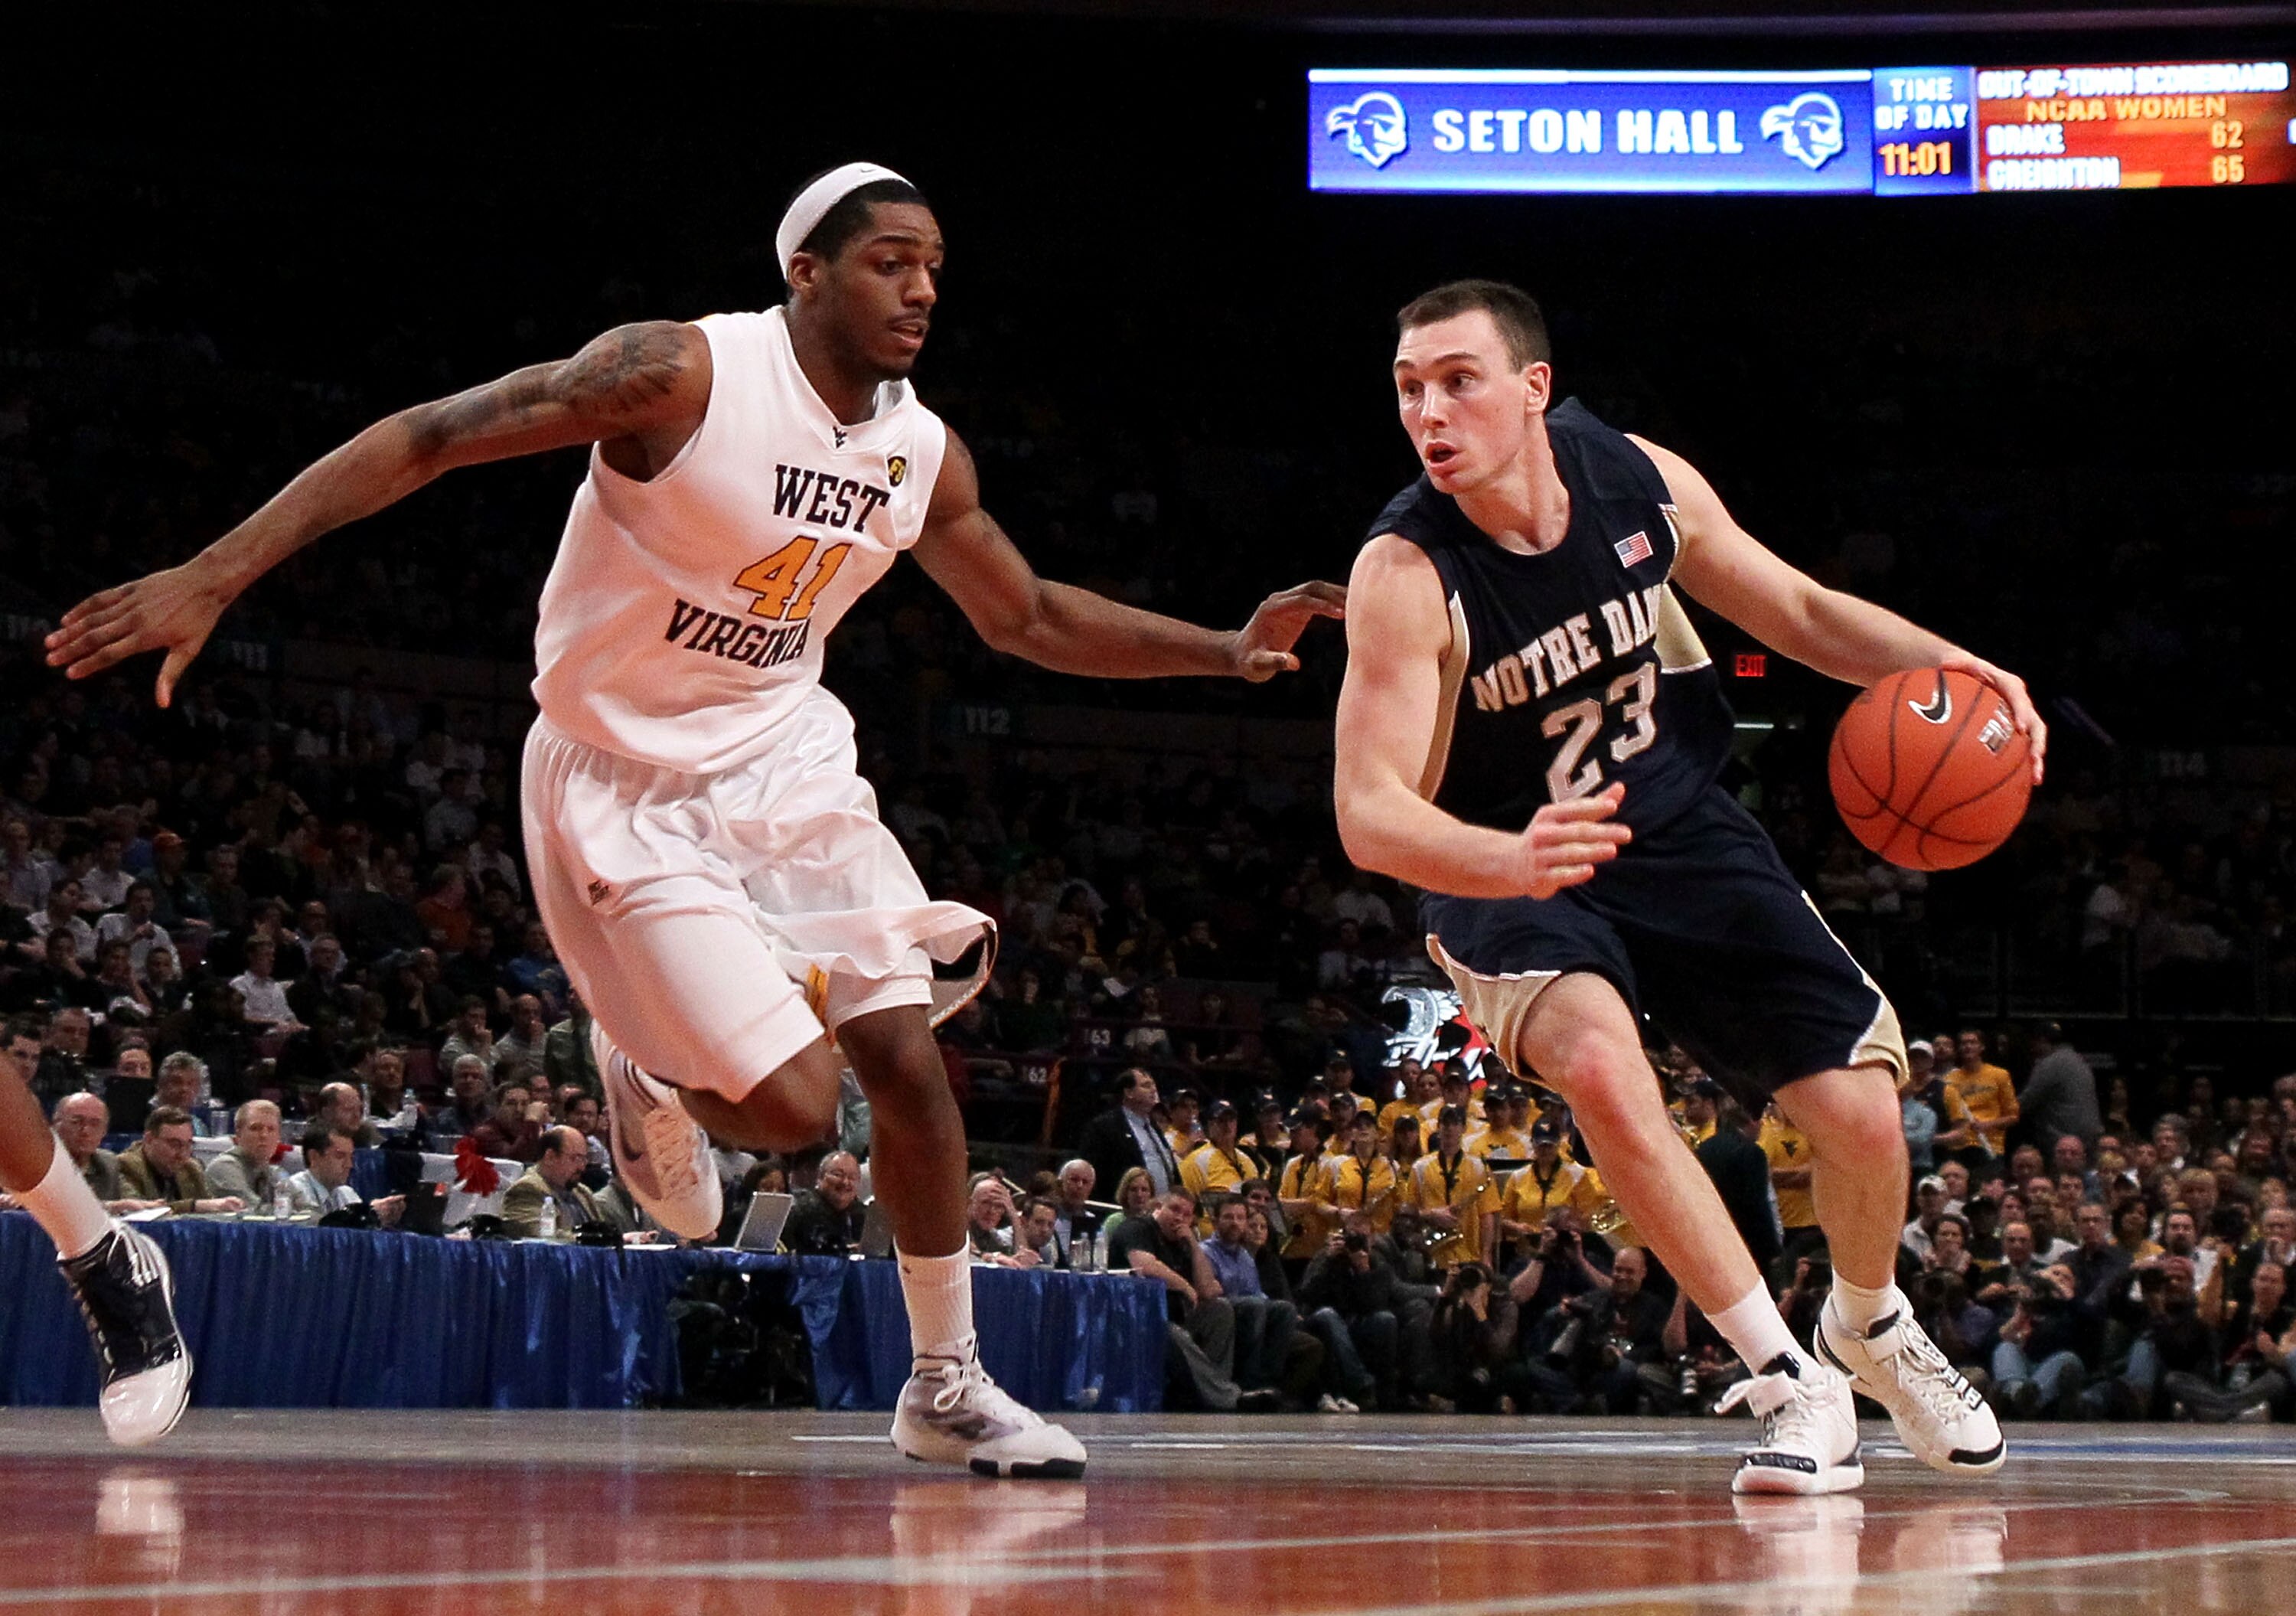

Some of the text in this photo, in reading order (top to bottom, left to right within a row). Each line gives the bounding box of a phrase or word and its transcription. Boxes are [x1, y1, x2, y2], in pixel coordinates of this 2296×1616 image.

[1890, 77, 1953, 102] TIME
[1978, 67, 2135, 99] OUT-OF-TOWN
[1875, 104, 1968, 129] OF DAY
[2027, 96, 2227, 122] NCAA WOMEN
[1432, 109, 1743, 154] SETON HALL
[1987, 121, 2244, 155] DRAKE 62
[1878, 141, 1952, 176] 11:01
[2212, 155, 2245, 183] 65
[773, 464, 890, 533] WEST
[733, 535, 853, 622] 41
[664, 599, 811, 668] VIRGINIA
[1470, 612, 1601, 712] NOTRE
[966, 706, 1010, 734] 112
[1541, 661, 1658, 804] 23
